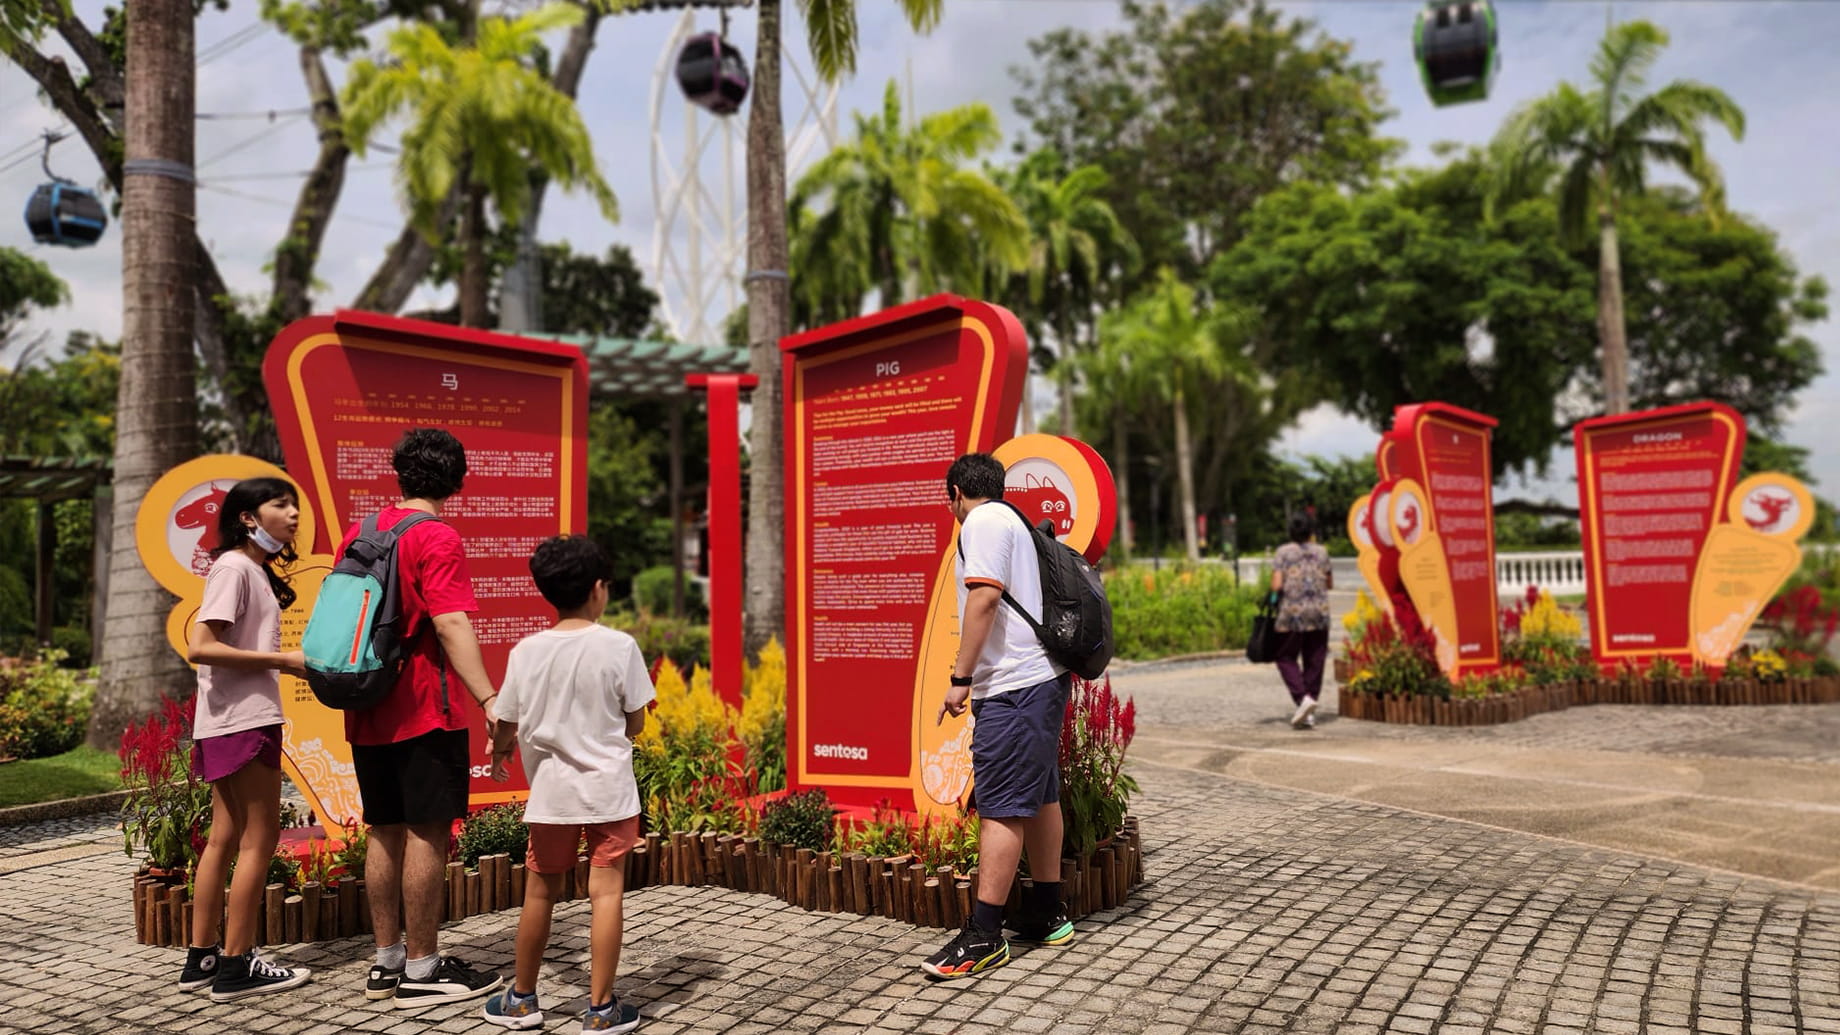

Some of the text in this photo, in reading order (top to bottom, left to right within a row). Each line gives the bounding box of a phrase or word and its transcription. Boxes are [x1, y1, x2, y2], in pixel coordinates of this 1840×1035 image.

[876, 361, 900, 377] PIG
[440, 373, 458, 390] 马
[1633, 432, 1682, 443] DRAGON
[814, 744, 868, 760] sentosa
